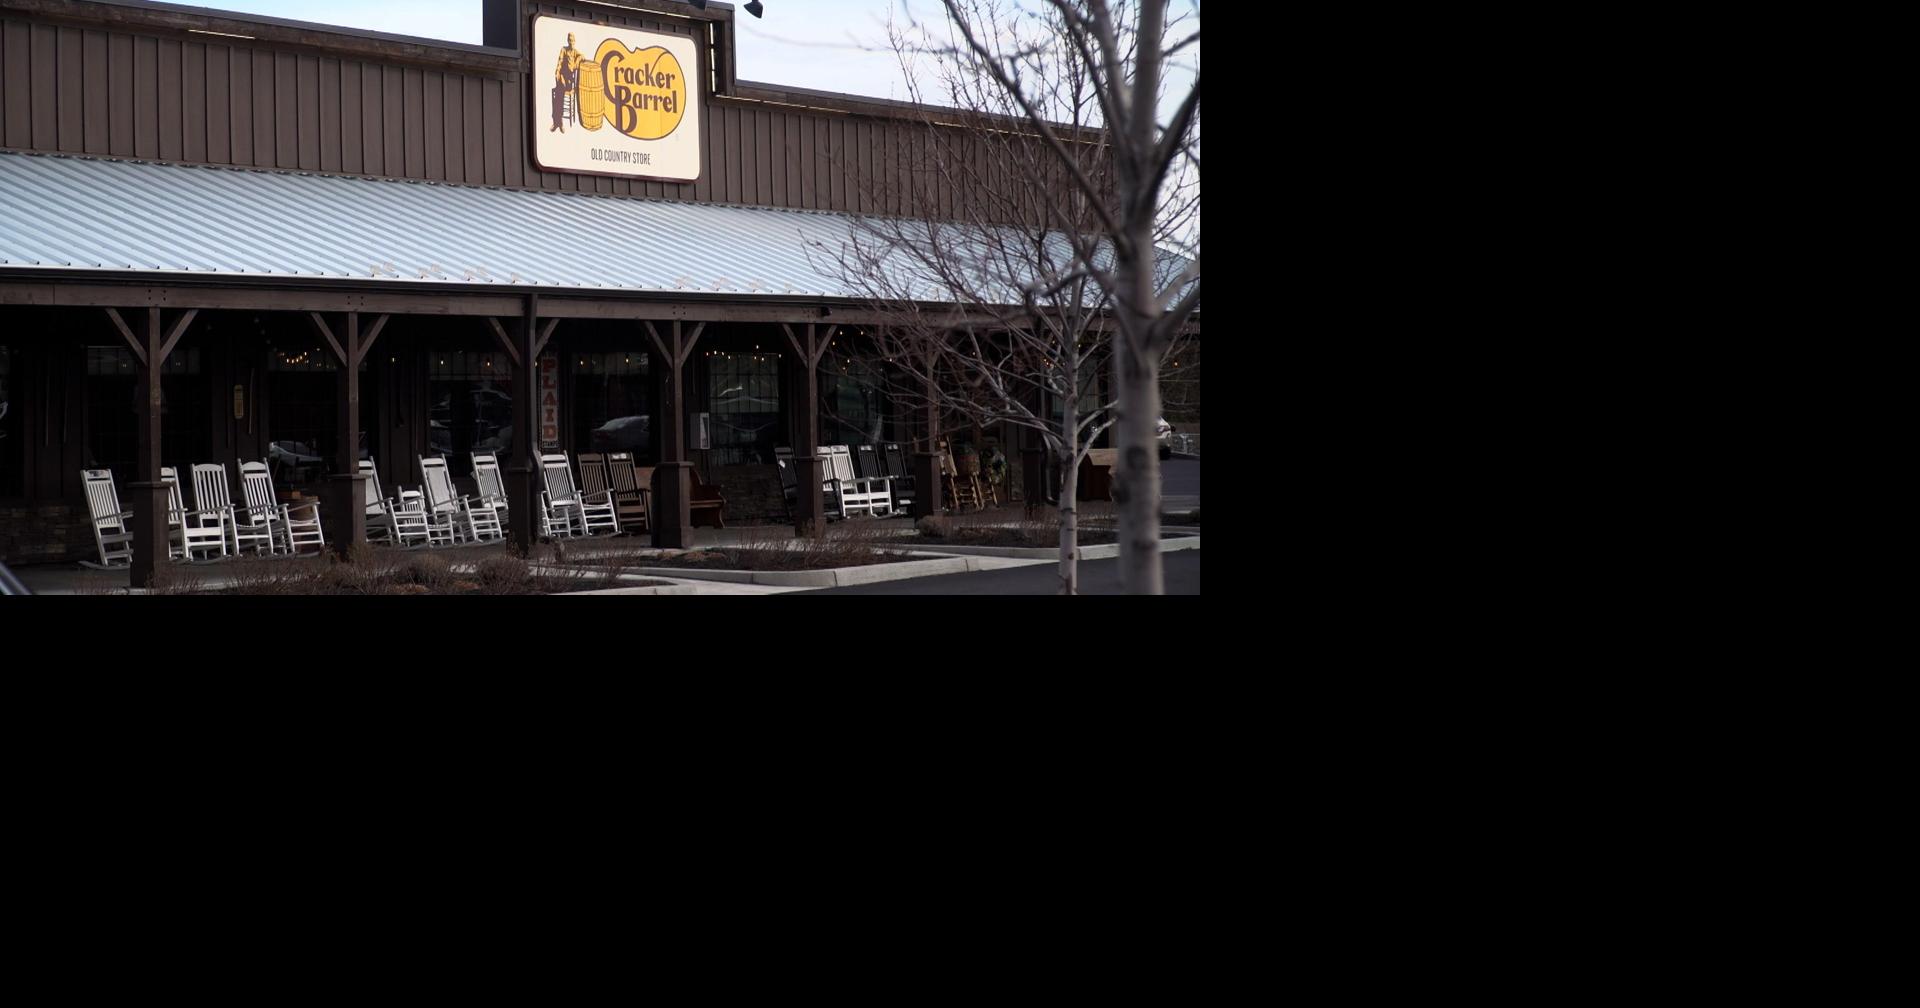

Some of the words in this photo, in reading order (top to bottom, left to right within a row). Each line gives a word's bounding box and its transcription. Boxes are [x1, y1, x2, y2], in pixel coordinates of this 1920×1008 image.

[601, 50, 675, 104] Cracker
[614, 85, 678, 134] Barrel
[591, 148, 602, 160] OLD
[604, 150, 631, 163] COUNTRY
[633, 152, 651, 165] STORE
[543, 359, 557, 439] PLAID
